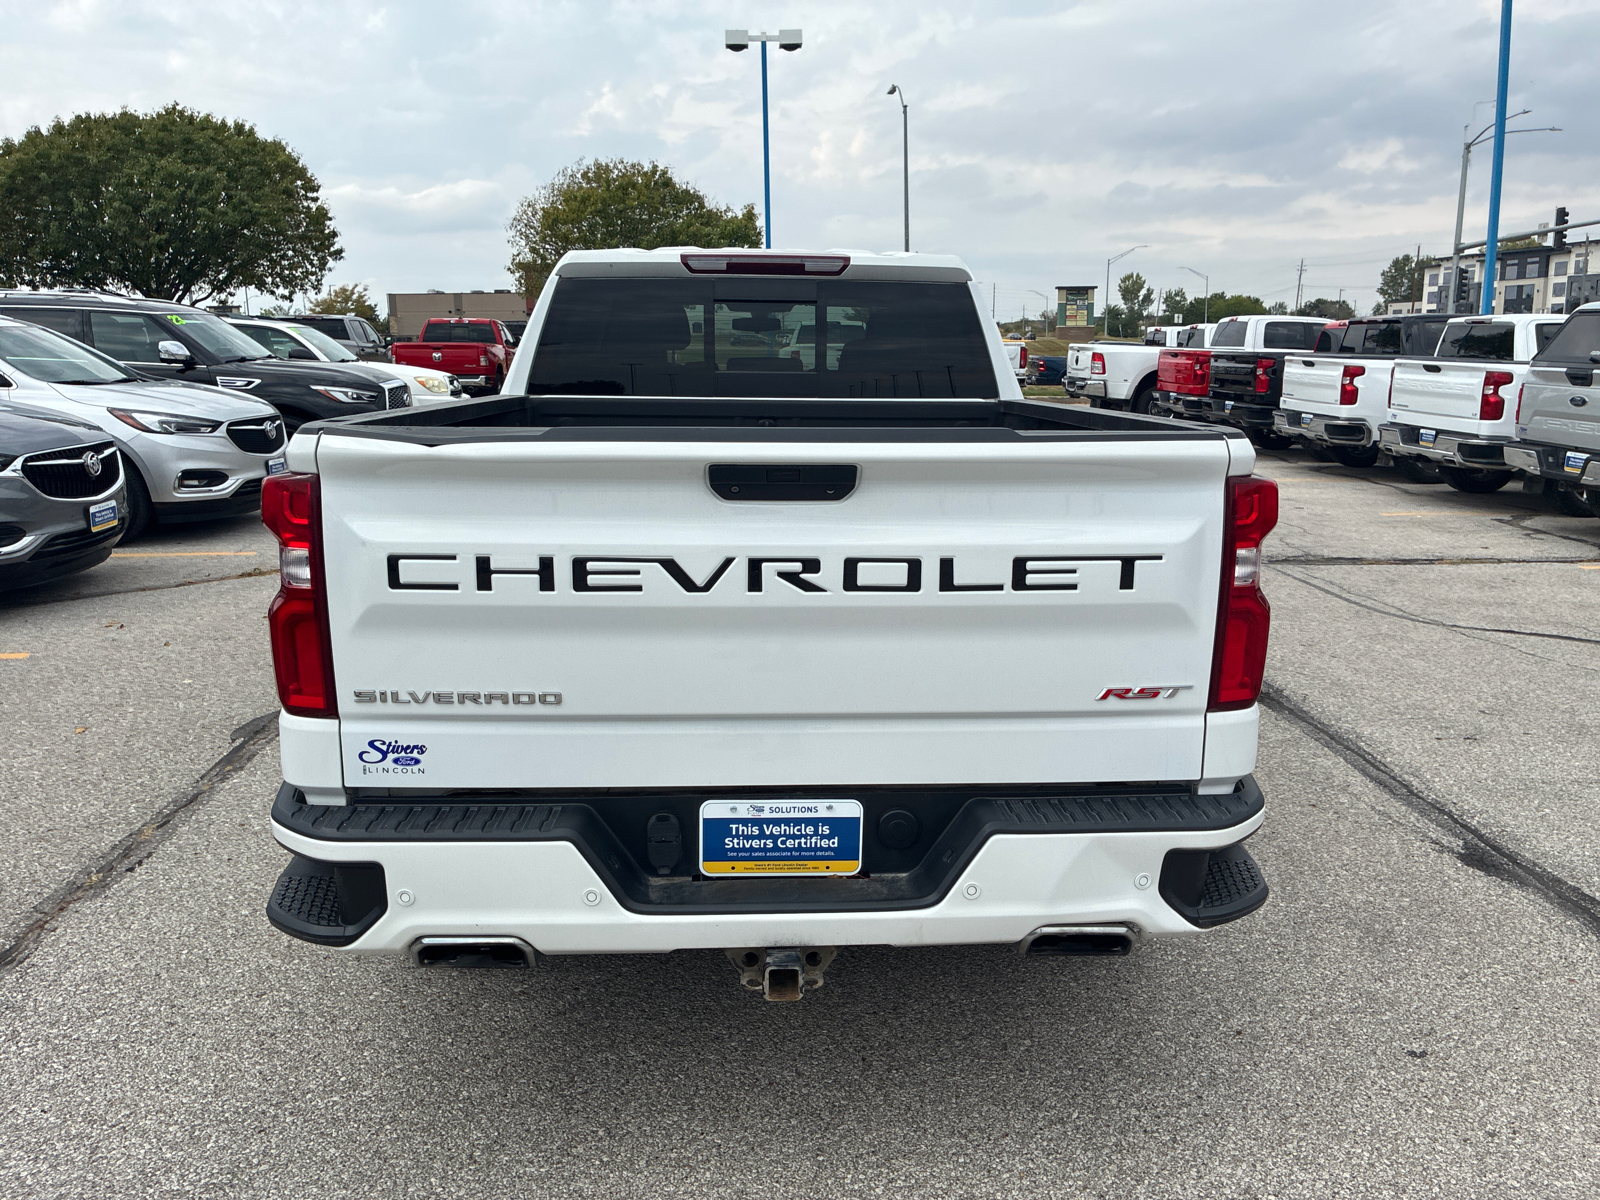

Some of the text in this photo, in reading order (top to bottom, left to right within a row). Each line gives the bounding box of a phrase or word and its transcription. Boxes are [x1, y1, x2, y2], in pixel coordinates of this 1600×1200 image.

[387, 553, 1164, 594] CHEVROLET
[353, 689, 563, 705] SILVERADO
[1094, 685, 1194, 701] RST
[358, 739, 428, 764] Stivers
[397, 757, 416, 765] Ford
[368, 767, 425, 775] LINCOLN
[768, 806, 819, 814] SOLUTIONS
[729, 823, 830, 836] This Vehicle is
[724, 836, 838, 849] Stivers Certified
